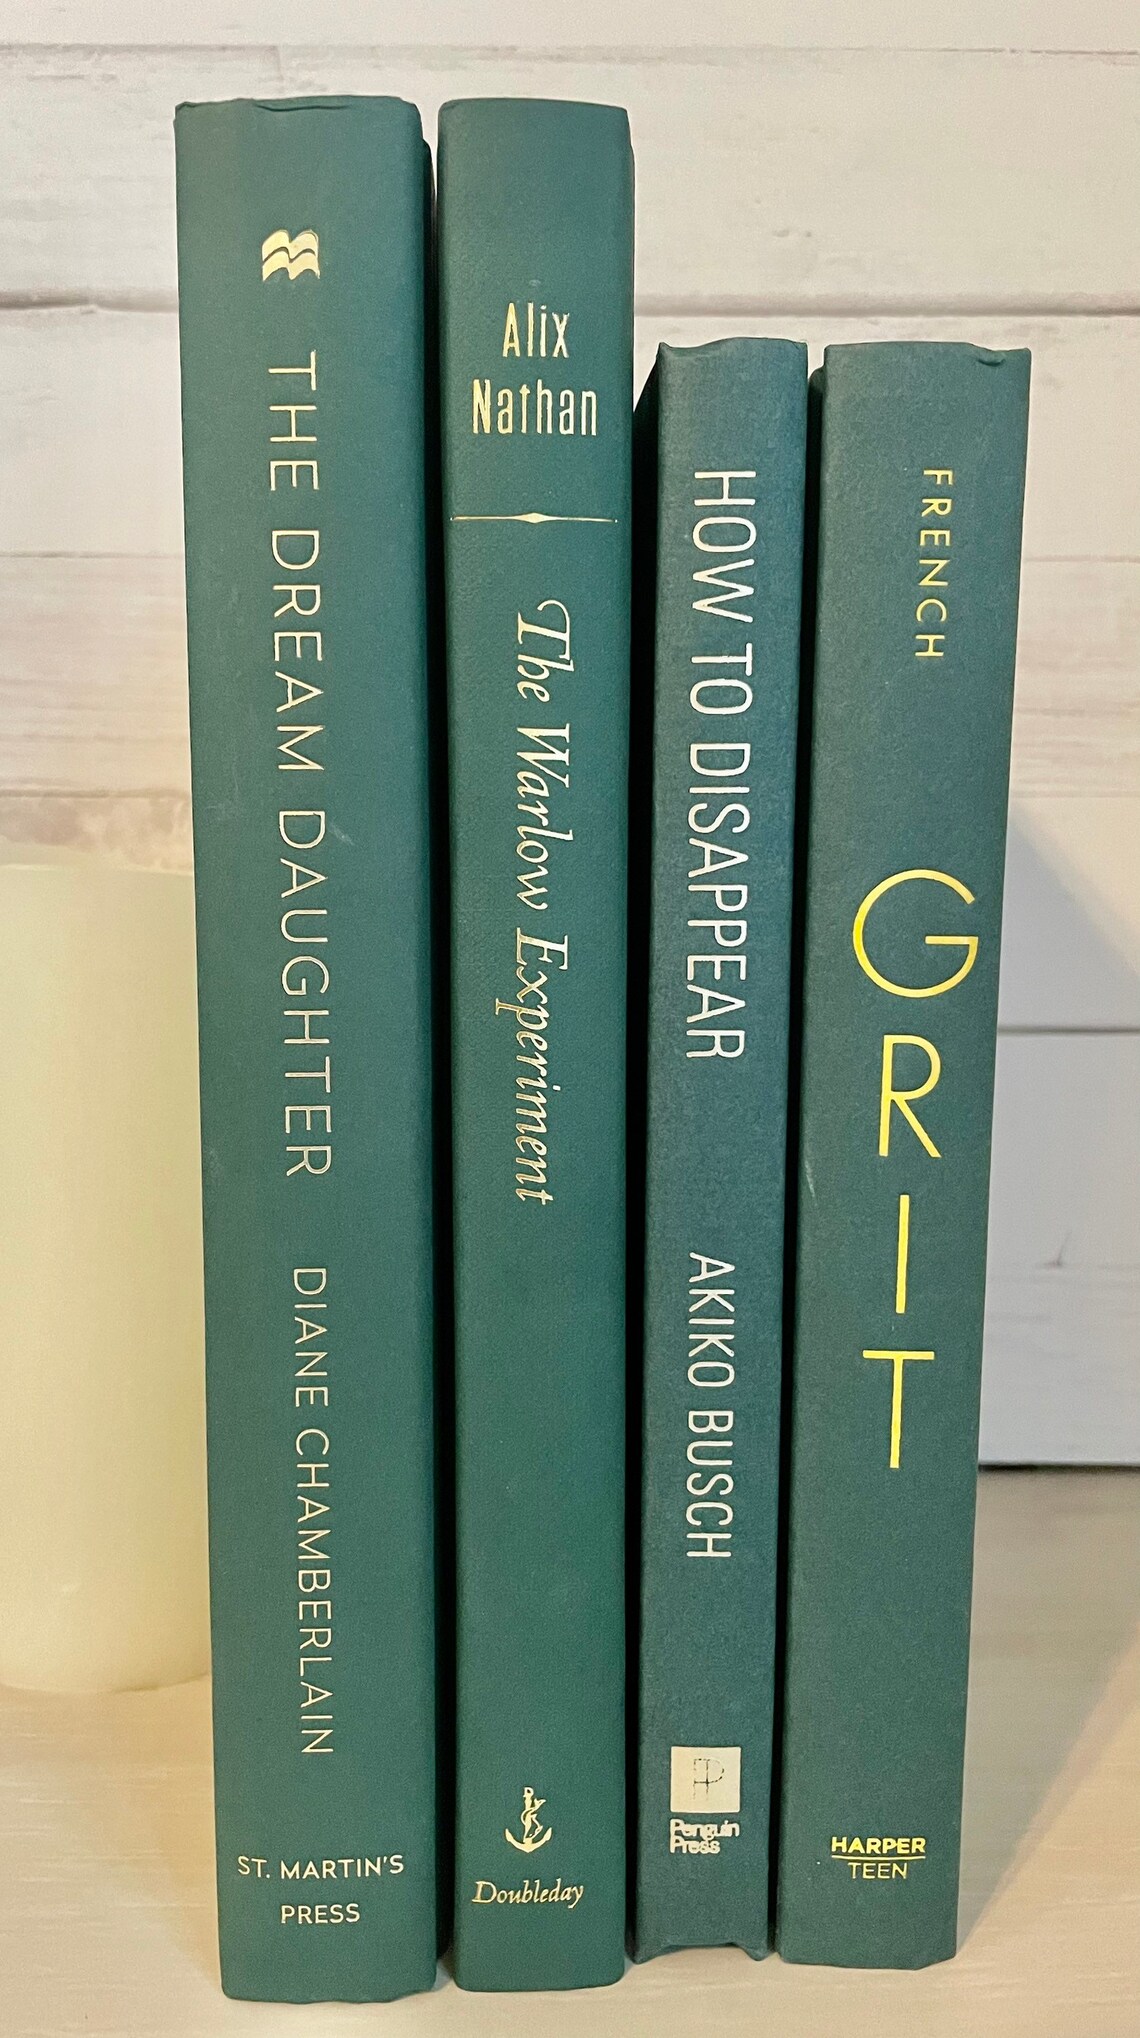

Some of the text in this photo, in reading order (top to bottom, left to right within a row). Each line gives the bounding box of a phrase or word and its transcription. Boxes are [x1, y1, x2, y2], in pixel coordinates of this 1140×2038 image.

[503, 303, 569, 357] Alix
[473, 379, 596, 435] Nathan
[915, 470, 953, 656] FRENCH
[269, 350, 331, 1176] THE DREAM DAUGHTER
[686, 471, 756, 1057] HOW TO DISAPPEAR
[496, 600, 574, 1205] The Warlow Experiment
[853, 870, 979, 1468] GRIT
[686, 1252, 735, 1557] AKIKO BUSCH
[294, 1269, 333, 1752] DIANE CHAMBERLAIN
[670, 1819, 740, 1838] Penguin
[670, 1837, 720, 1854] Press
[831, 1836, 926, 1853] HARPER
[238, 1855, 403, 1879] ST. MARTIN'S
[472, 1878, 583, 1908] Doubleday
[848, 1862, 908, 1879] TEEN
[282, 1904, 359, 1924] PRESS
